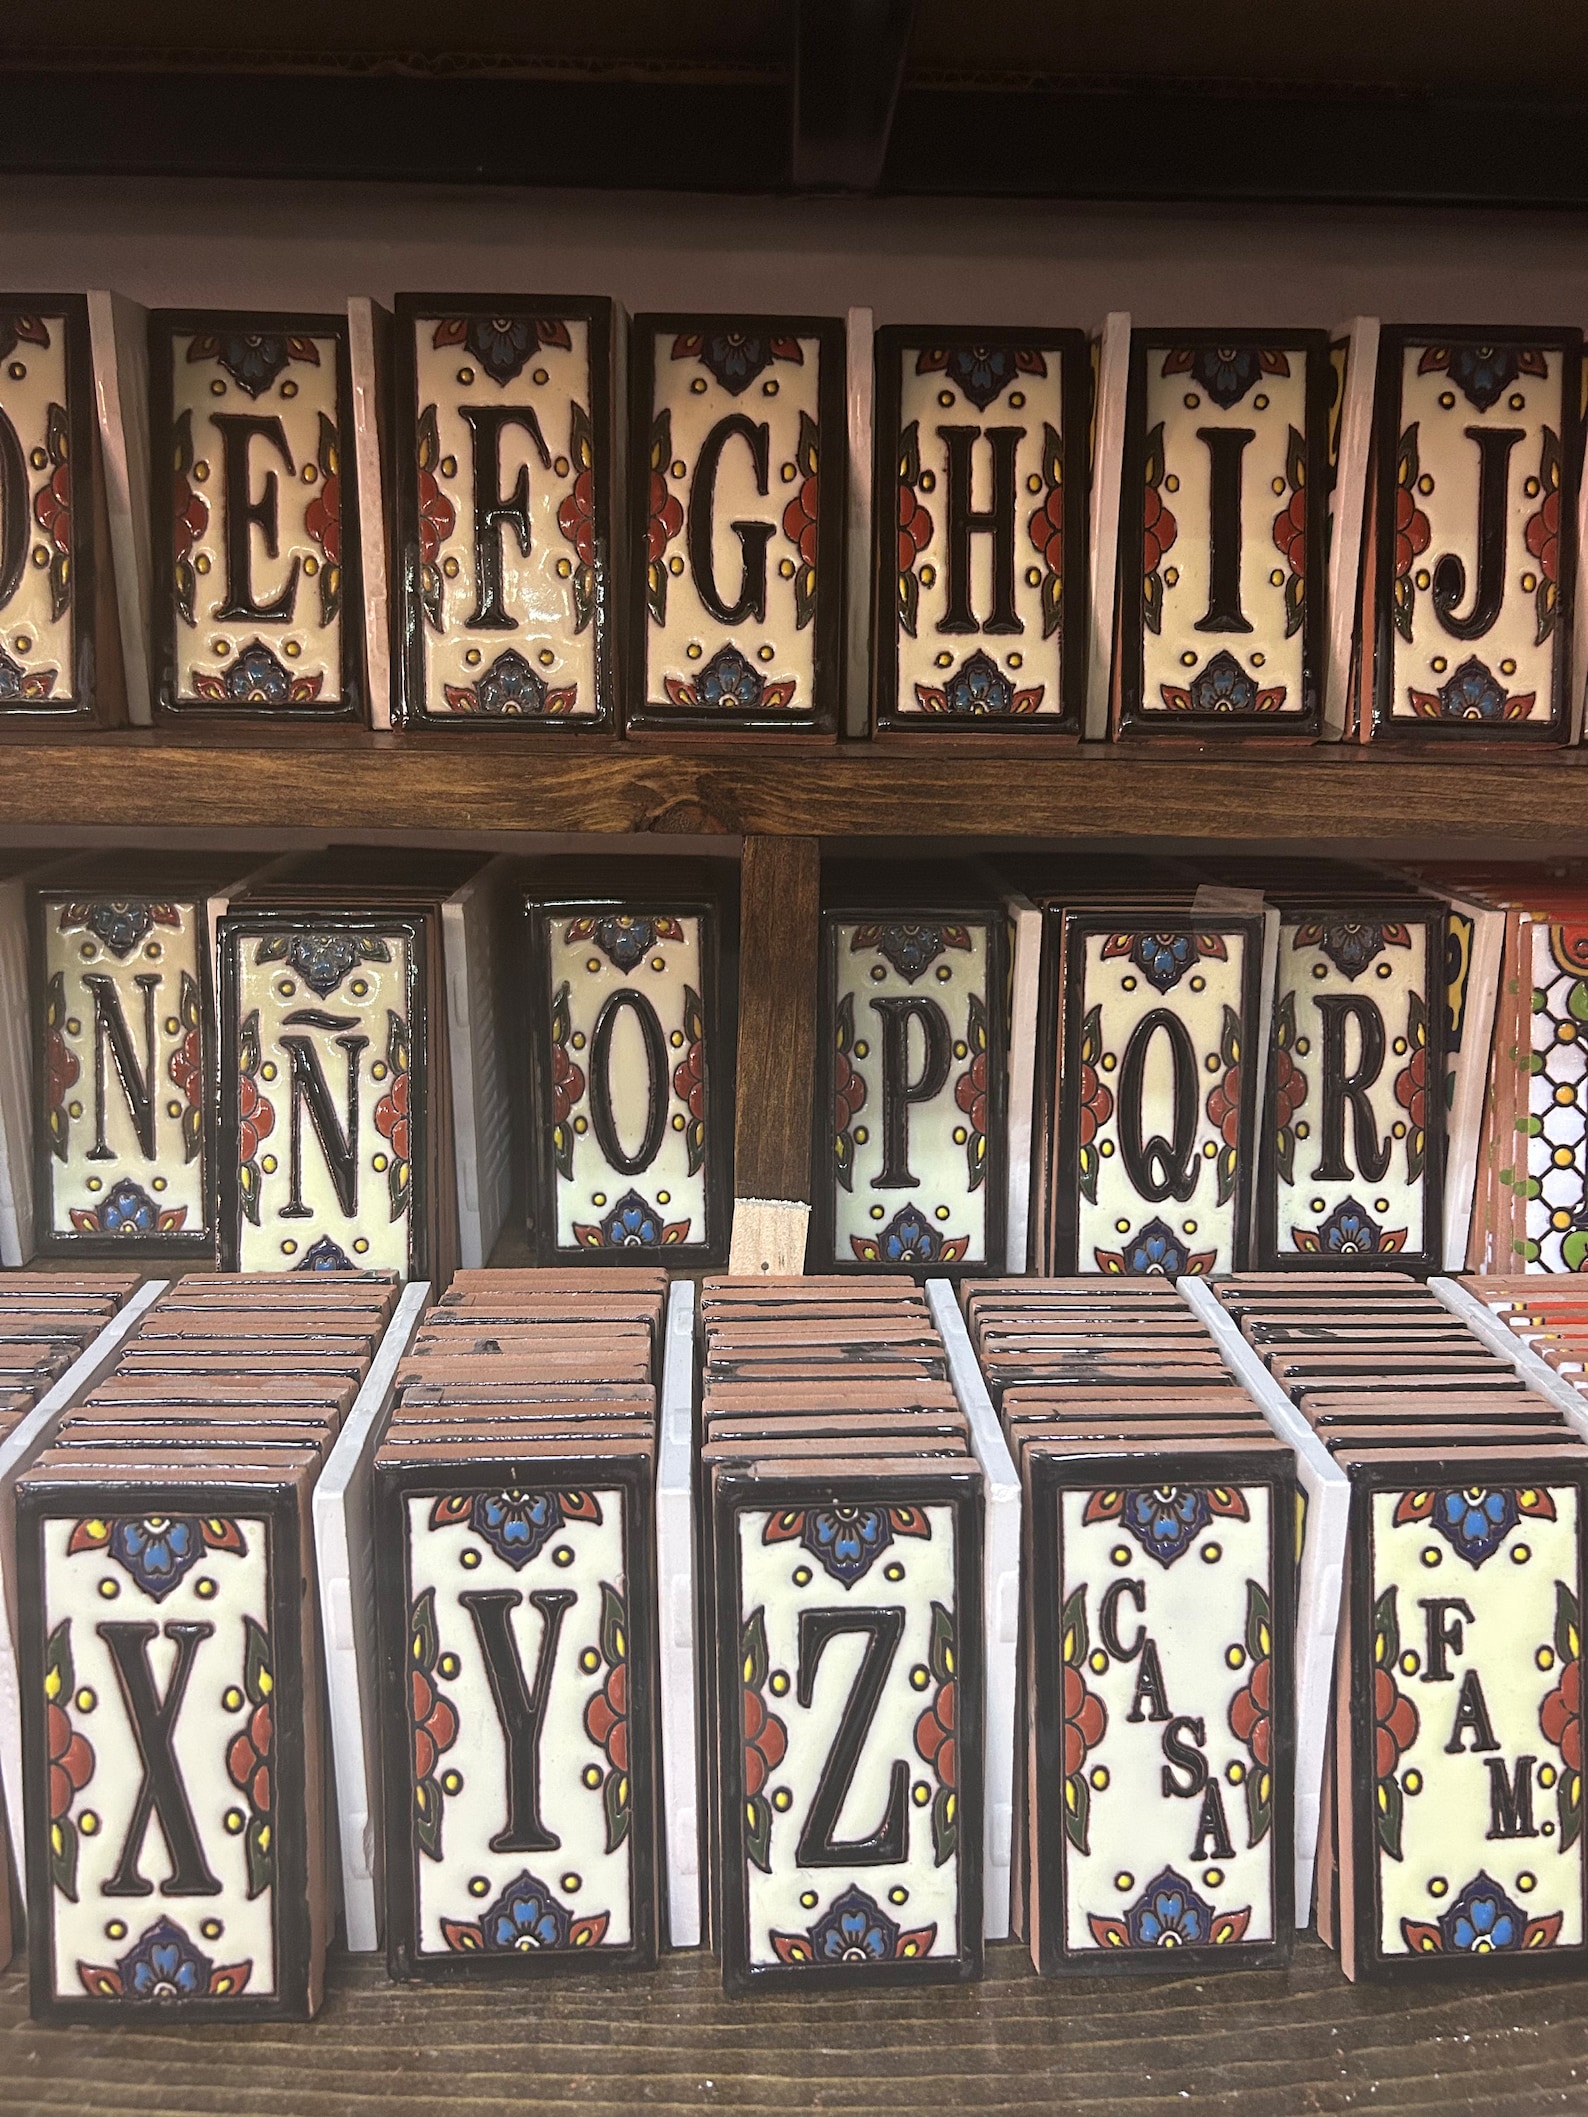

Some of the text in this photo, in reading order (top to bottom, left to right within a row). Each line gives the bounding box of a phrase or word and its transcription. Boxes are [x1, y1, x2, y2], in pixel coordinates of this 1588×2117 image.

[210, 412, 298, 623] E
[458, 405, 552, 631] F
[689, 414, 776, 624] G
[936, 425, 1025, 635] H
[1194, 427, 1256, 633] I
[1433, 427, 1526, 640] J
[82, 973, 162, 1161] N
[279, 1008, 369, 1218] Ñ
[590, 988, 669, 1175] O
[870, 995, 952, 1189] P
[1116, 1008, 1200, 1203] Q
[1311, 994, 1392, 1182] R
[96, 1621, 223, 1897] X
[458, 1589, 578, 1852] Y
[797, 1605, 910, 1867] Z
[1099, 1577, 1237, 1861] CASA
